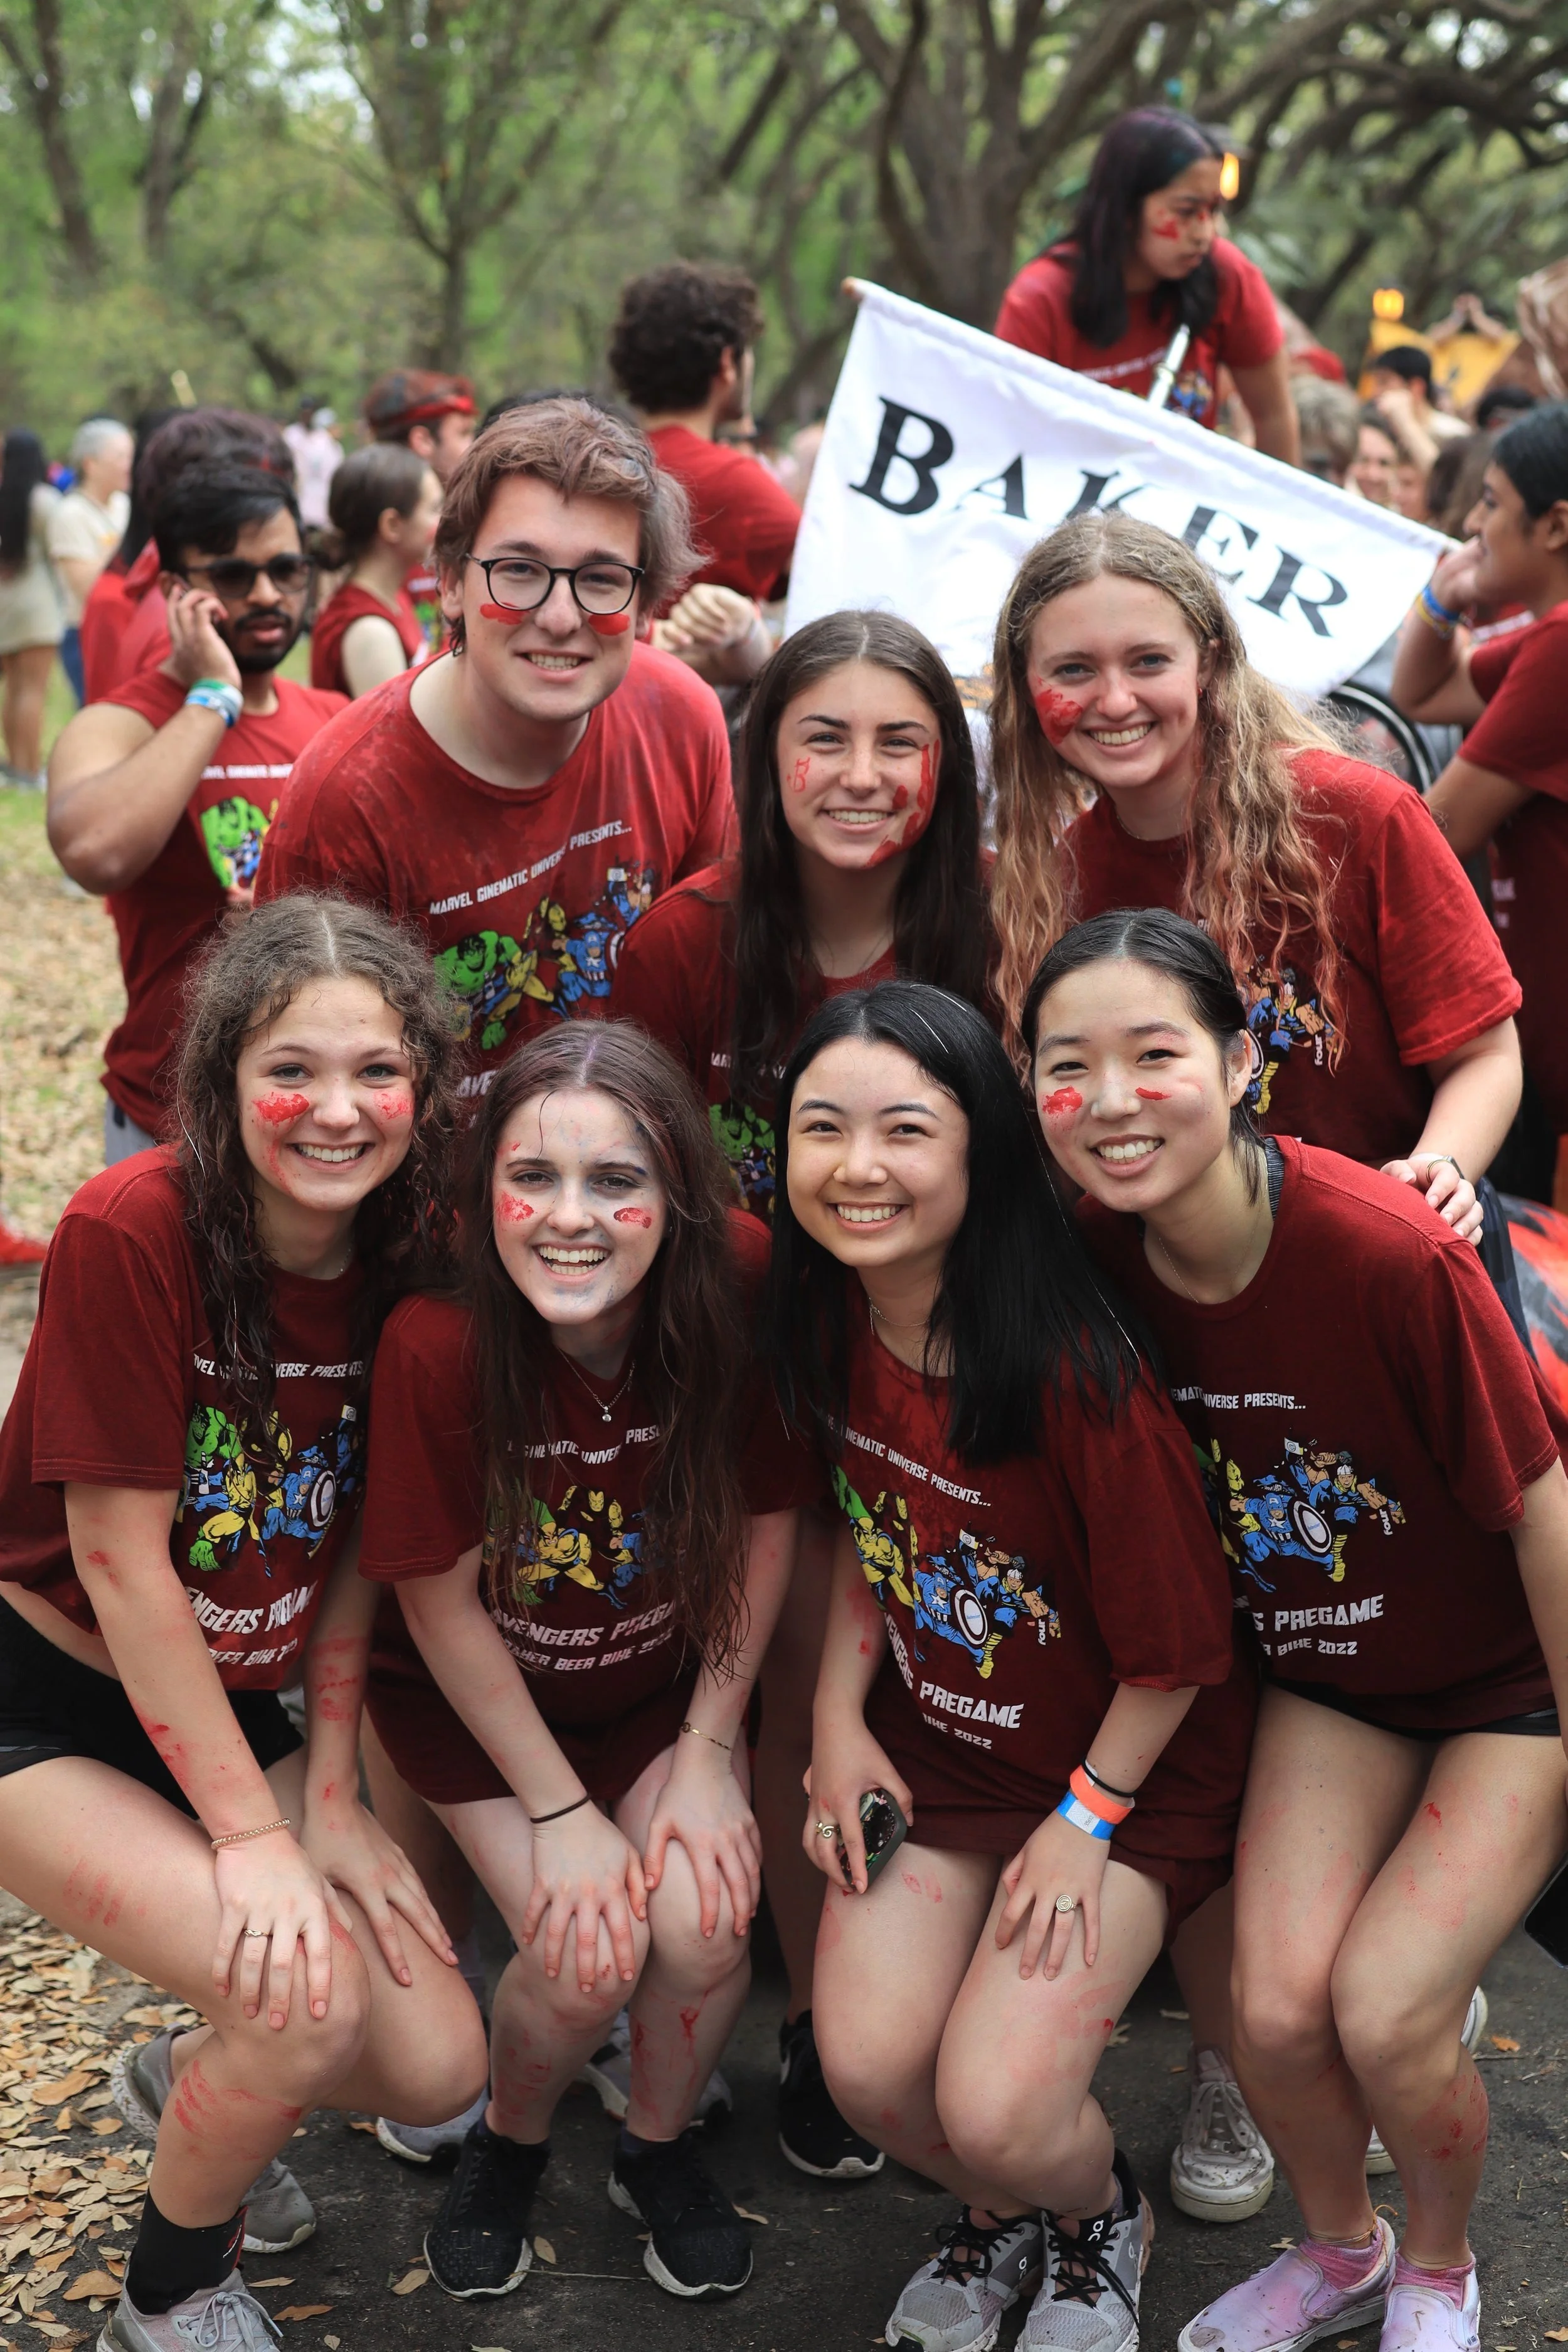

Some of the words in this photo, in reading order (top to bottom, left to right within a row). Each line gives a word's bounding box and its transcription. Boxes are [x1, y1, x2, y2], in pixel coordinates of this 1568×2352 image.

[849, 396, 1349, 638] BAKER
[430, 893, 474, 914] MARVEL
[477, 869, 528, 903] CINEMATIC
[271, 1363, 310, 1378] VERSE
[1203, 1393, 1239, 1409] NIVERSE
[1244, 1392, 1306, 1409] PRESENTS...
[841, 1424, 886, 1458] INEMATIC
[887, 1448, 929, 1481] UNIVERSE
[930, 1473, 992, 1507] PRESENTS...
[1274, 1594, 1384, 1631] PREGAME
[554, 1657, 596, 1671] BEER
[598, 1646, 636, 1666] BIKE
[1278, 1638, 1312, 1656] BIKE
[1318, 1638, 1357, 1655] 2022
[884, 1612, 914, 1690] VENGERS
[919, 1681, 1024, 1729] PREGAME
[954, 1728, 993, 1750] 2022
